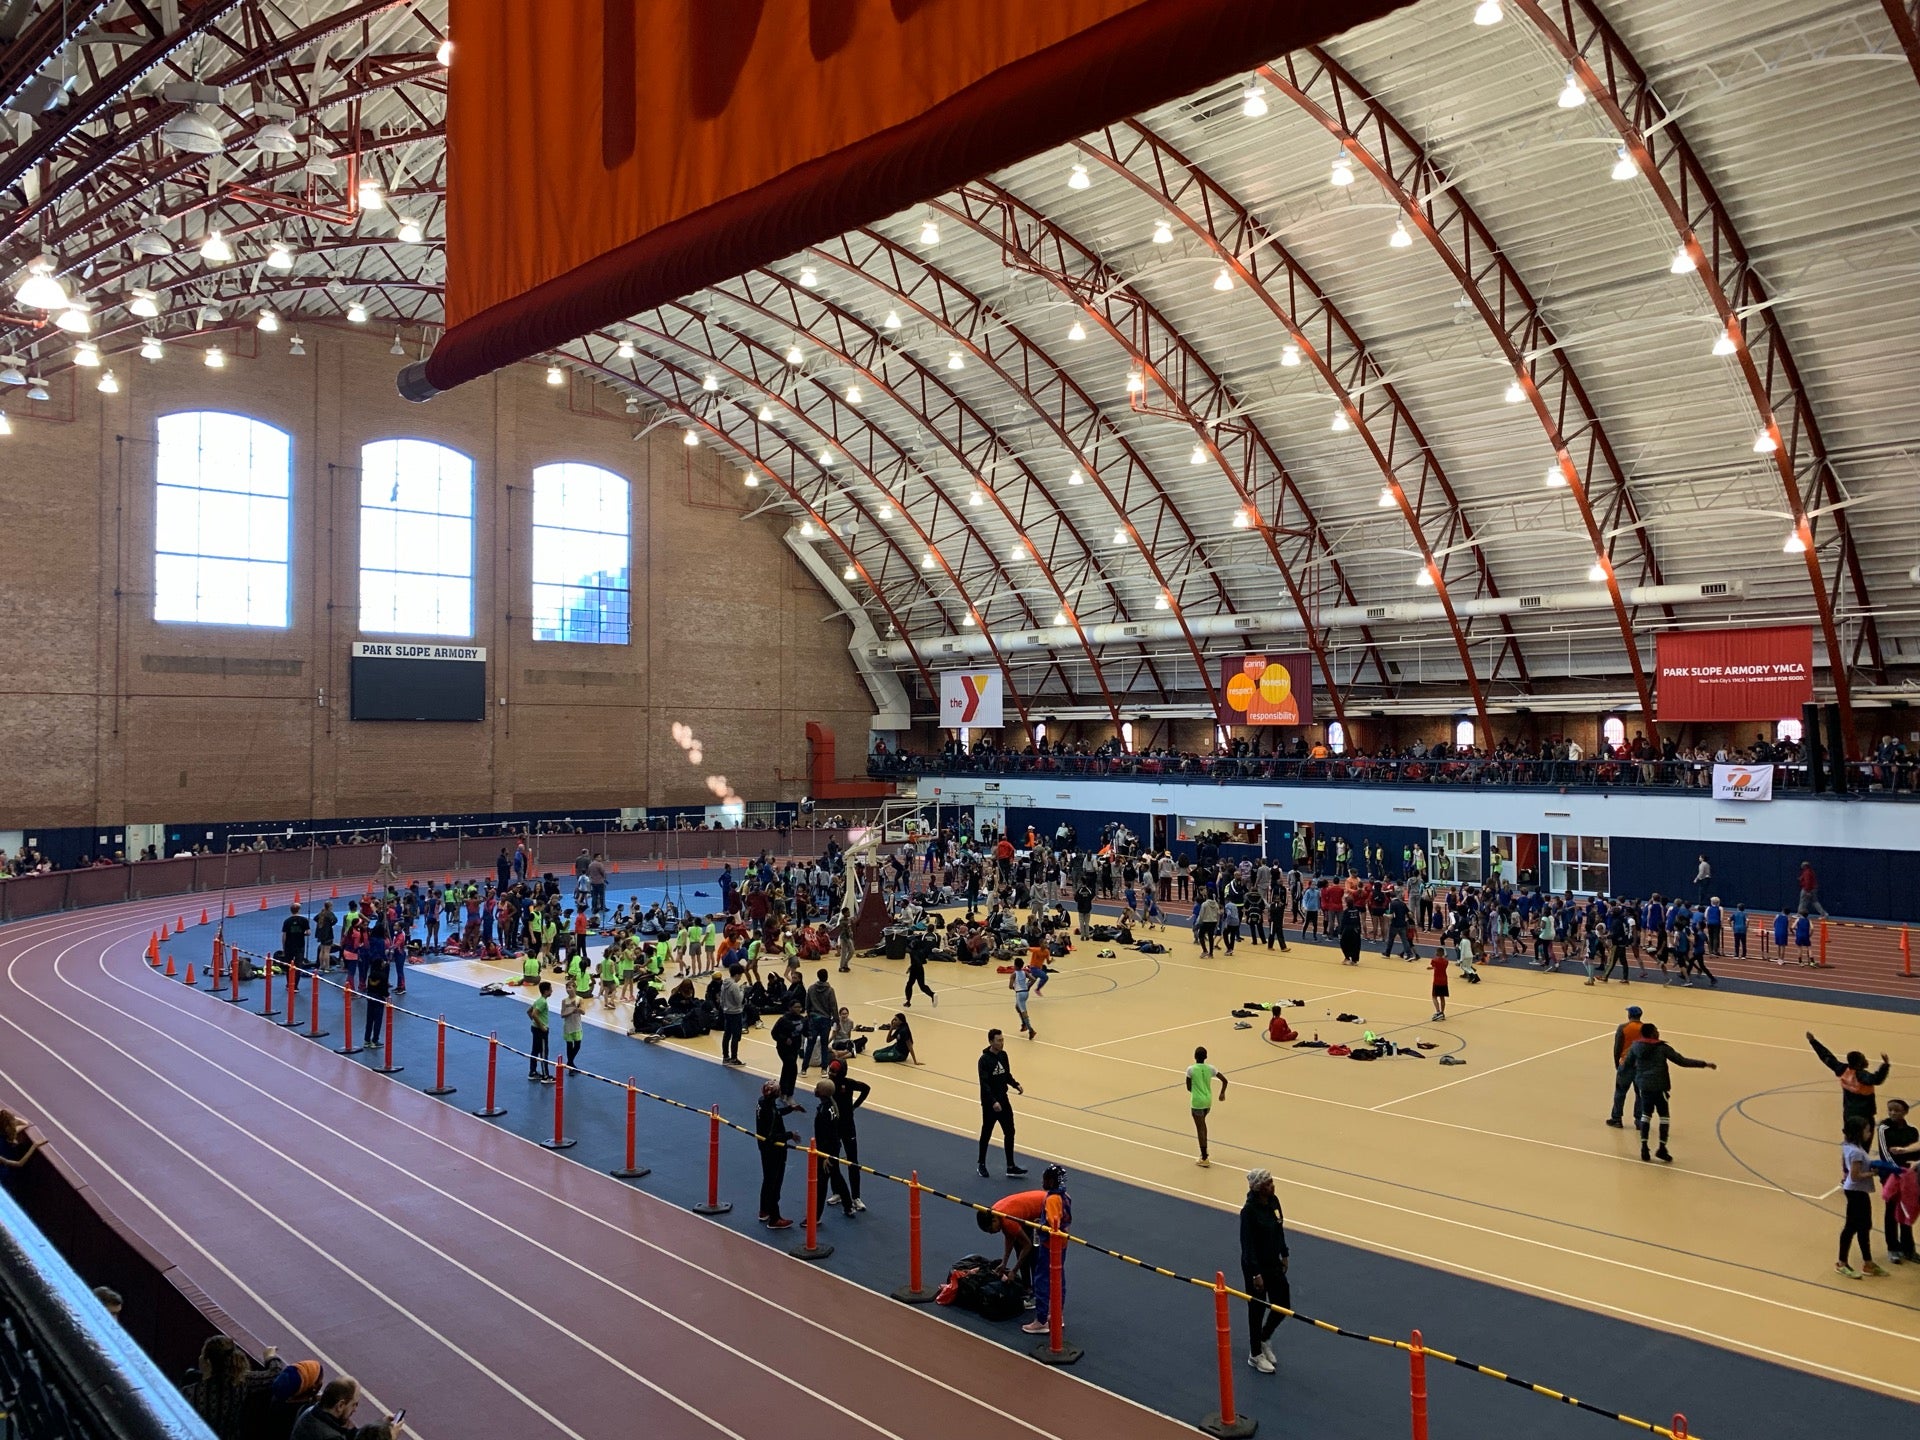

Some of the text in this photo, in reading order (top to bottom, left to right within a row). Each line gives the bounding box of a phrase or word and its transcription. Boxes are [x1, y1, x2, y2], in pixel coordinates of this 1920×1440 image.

[362, 645, 478, 658] PARK SLOPE ARMORY
[1244, 660, 1265, 669] caring
[1663, 664, 1804, 677] PARK SLOPE ARMORY YMCA
[950, 697, 963, 708] the
[1249, 711, 1296, 721] responsibility
